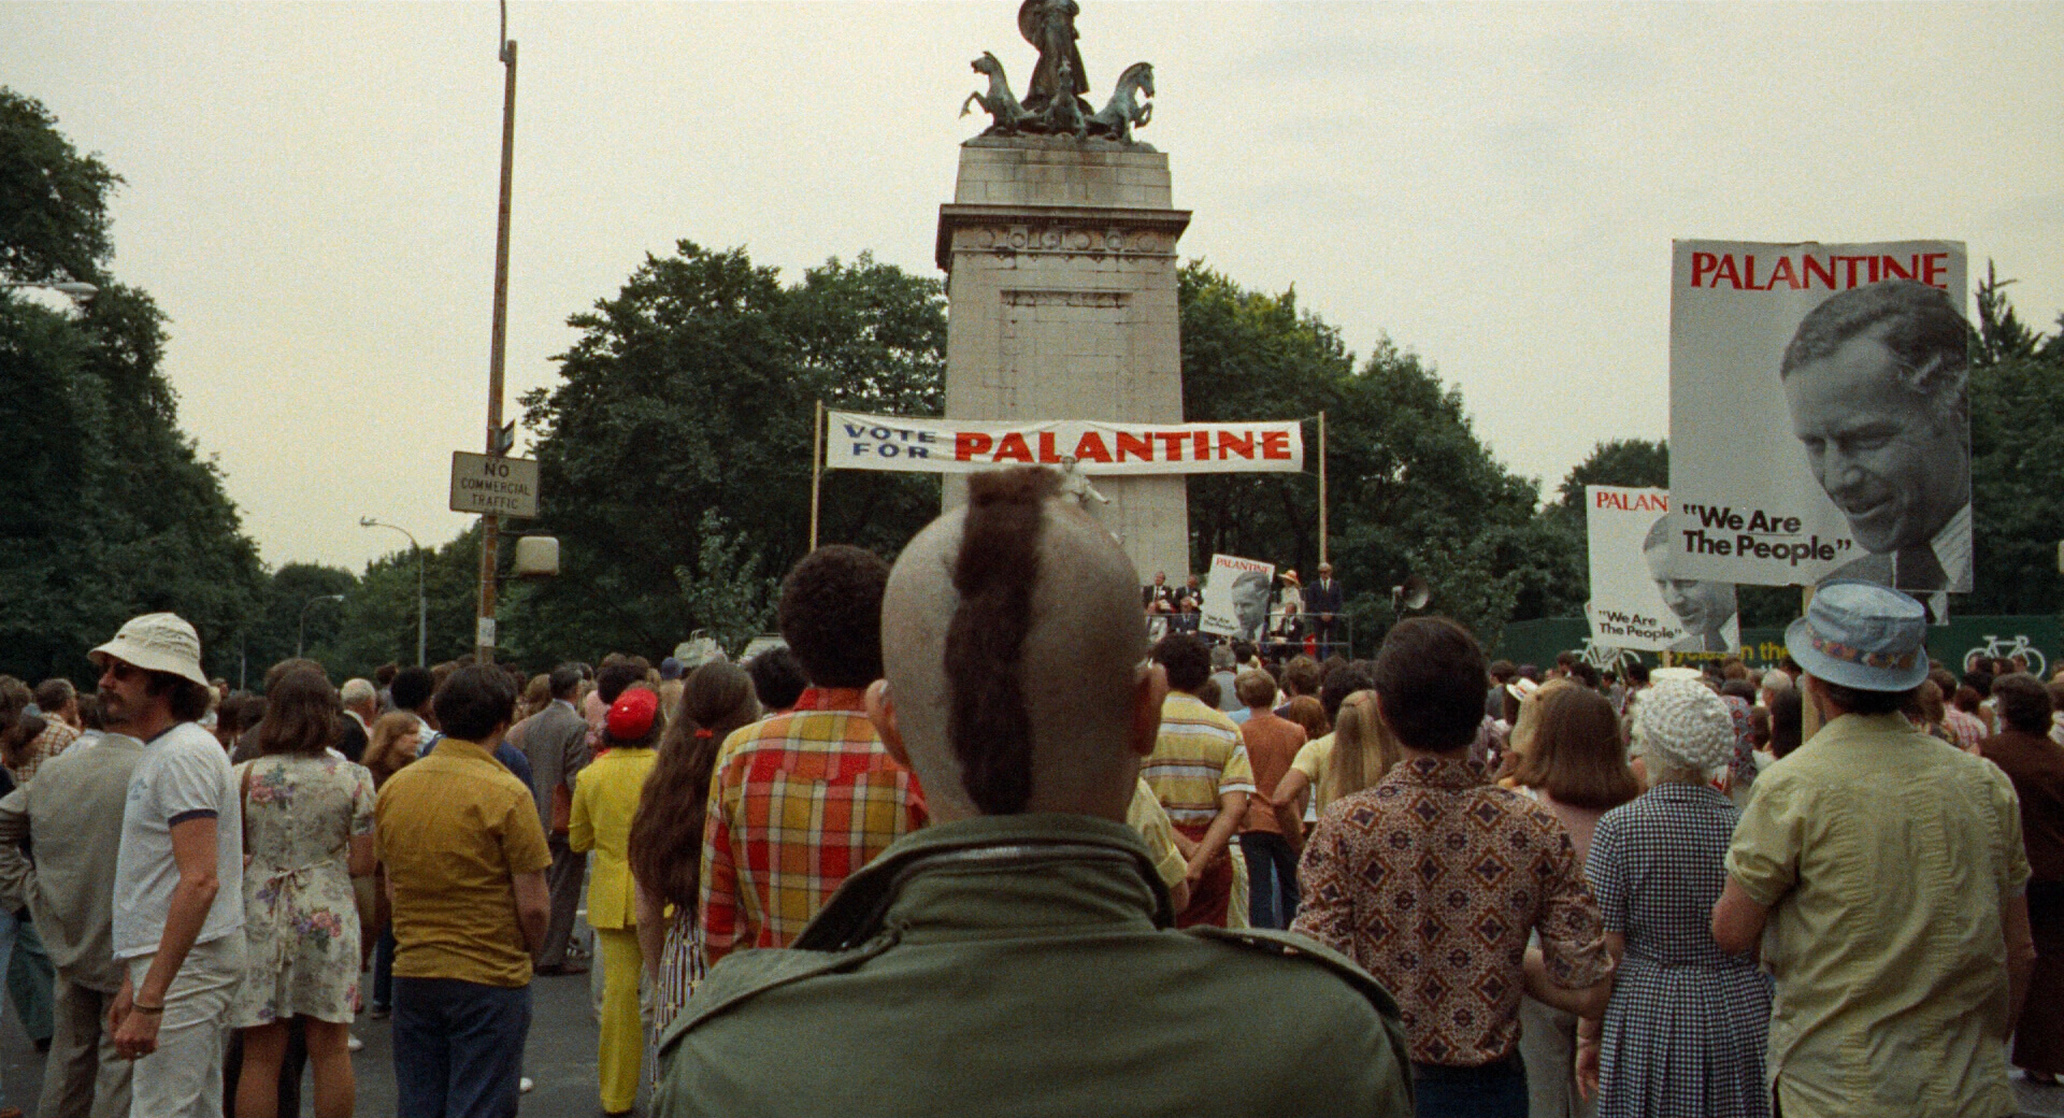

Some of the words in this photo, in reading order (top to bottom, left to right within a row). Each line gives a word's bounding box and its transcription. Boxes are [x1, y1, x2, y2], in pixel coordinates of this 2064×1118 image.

[1690, 251, 1949, 291] PALANTINE
[843, 423, 937, 443] VOTE
[852, 442, 930, 459] FOR
[954, 430, 1292, 464] PALANTINE
[484, 462, 510, 478] NO
[460, 477, 532, 497] COMMERCIAL
[472, 493, 518, 510] TRAFFIC
[1596, 491, 1669, 513] PALAN
[1747, 509, 1803, 534] Are
[1682, 529, 1732, 556] The
[1599, 622, 1625, 636] The
[1631, 613, 1657, 626] Are
